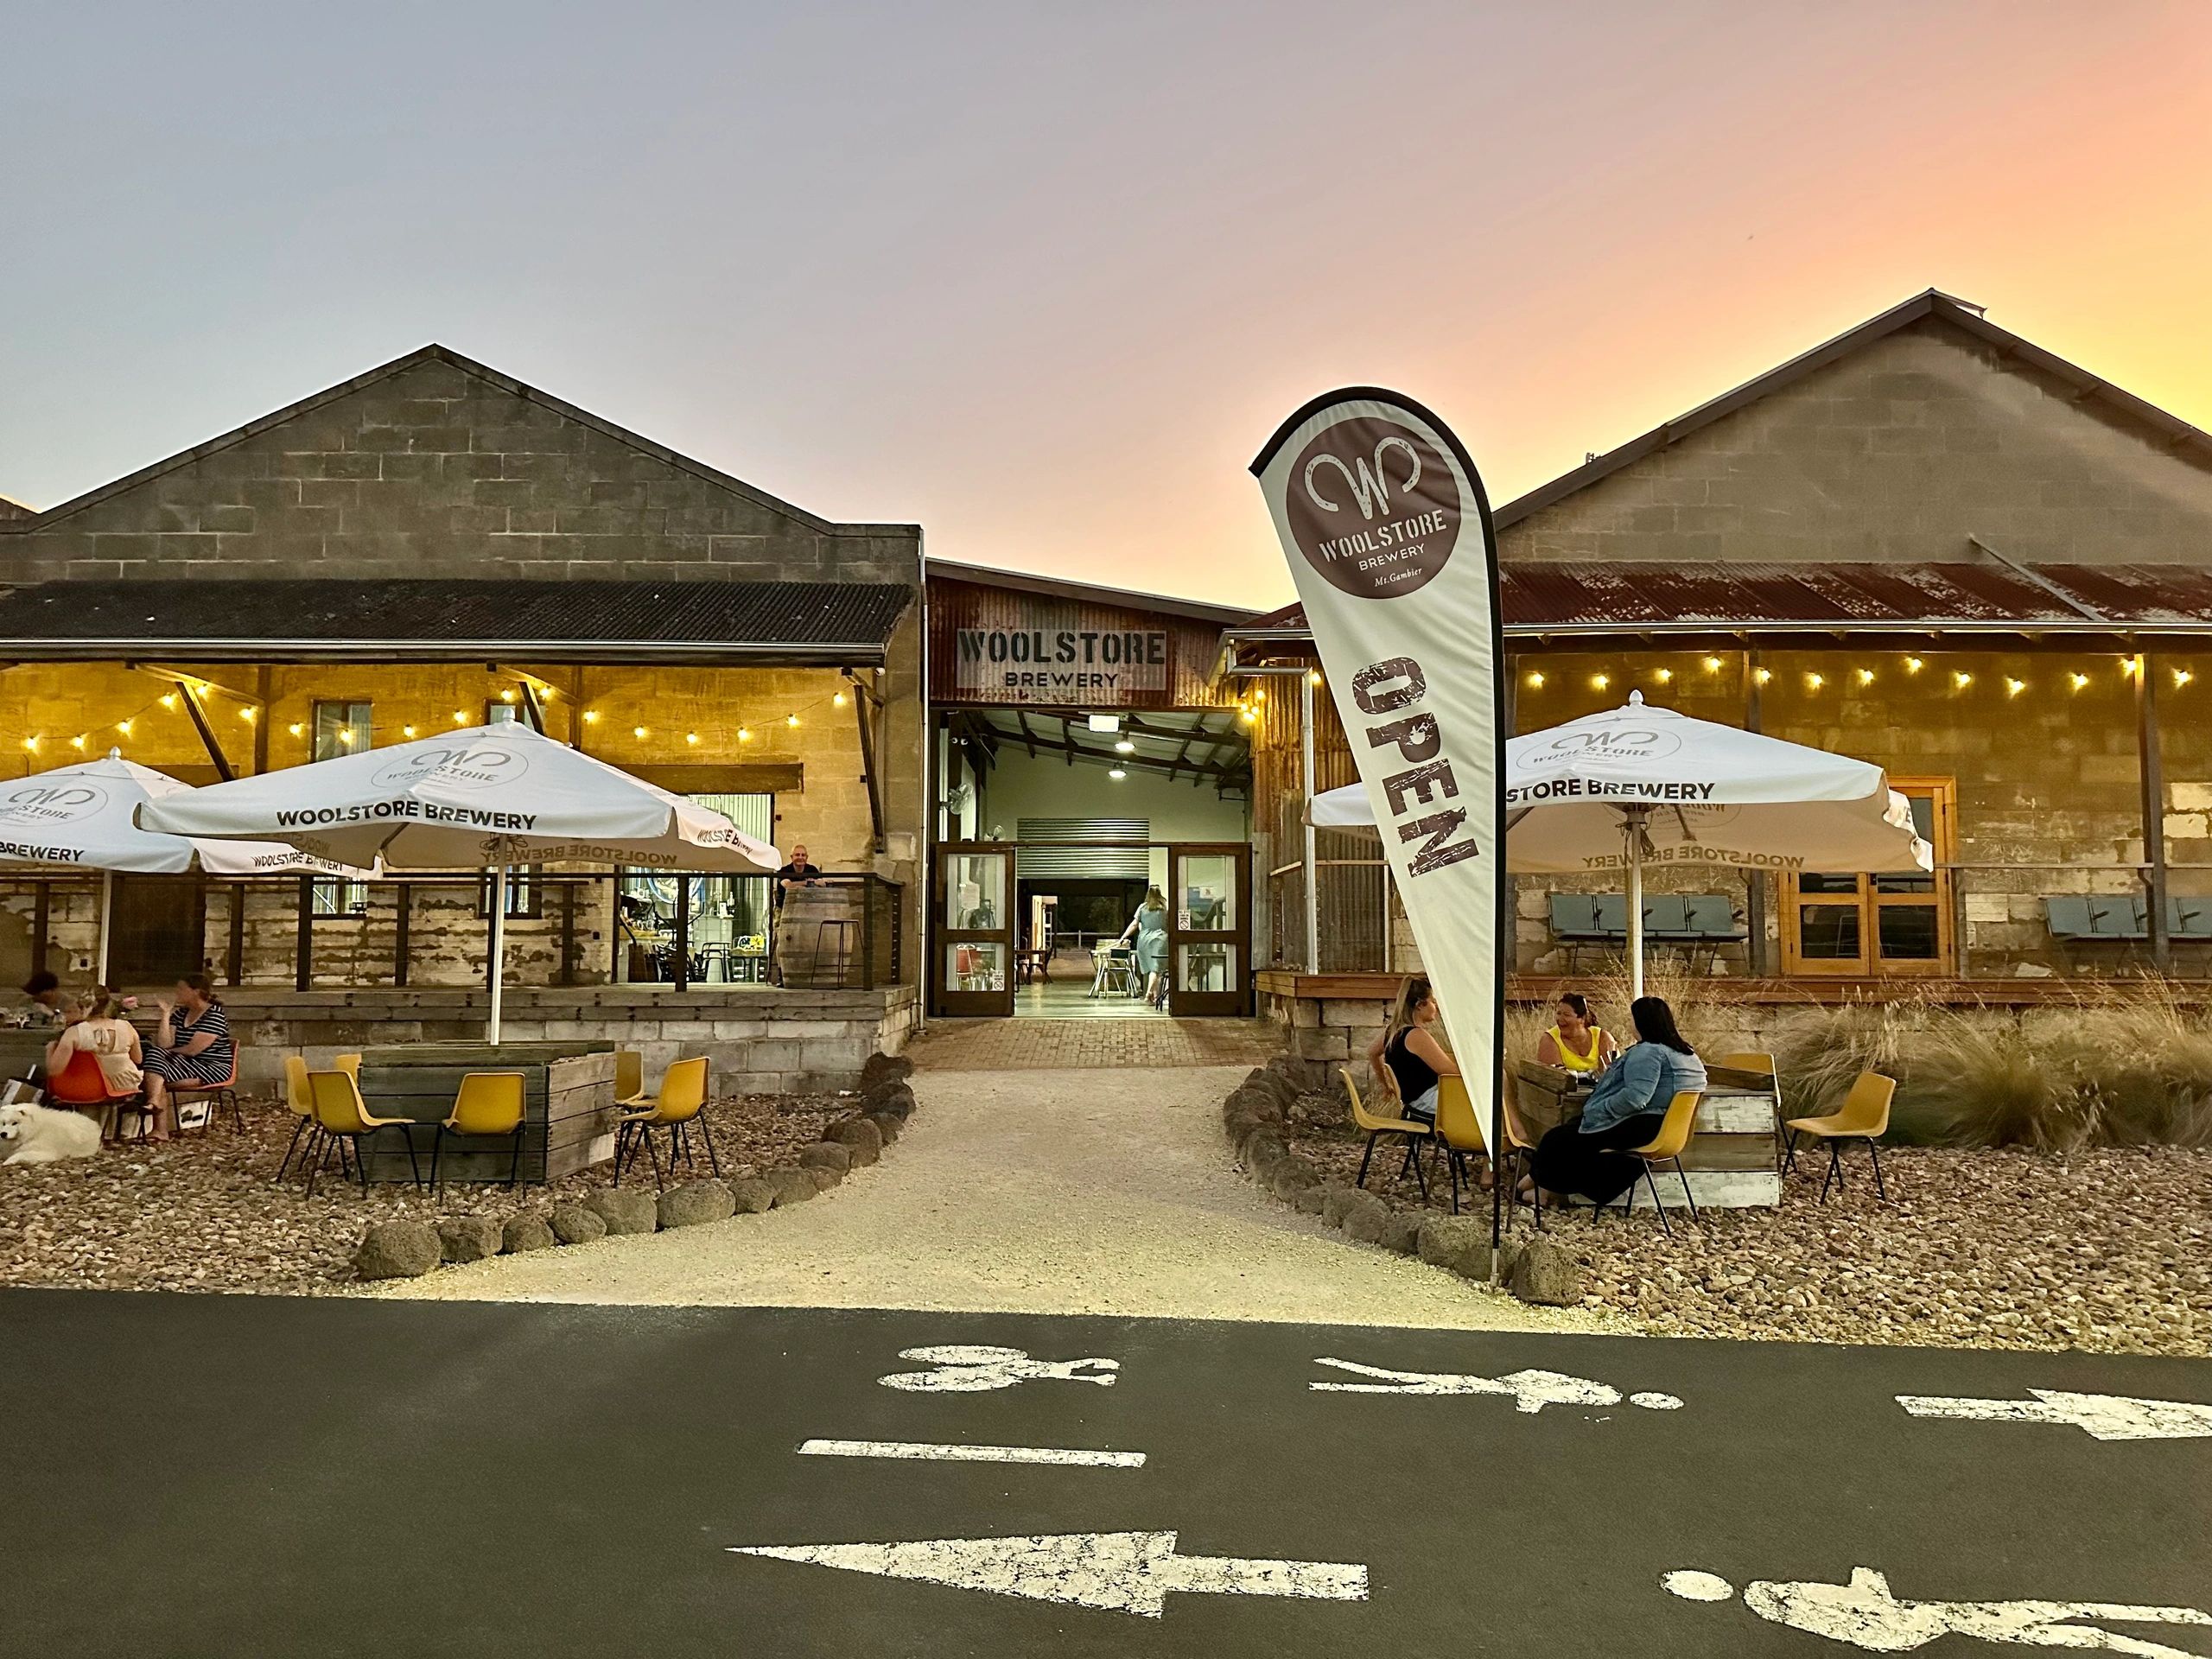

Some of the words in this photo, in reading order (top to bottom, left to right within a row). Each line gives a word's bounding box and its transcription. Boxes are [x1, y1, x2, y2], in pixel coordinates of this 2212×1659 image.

[1319, 509, 1447, 563] WOOLSTORE
[1358, 543, 1425, 571] BREWERY
[958, 631, 1166, 664] WOOLSTORE
[1005, 671, 1119, 688] BREWERY
[1352, 657, 1479, 878] OPEN
[1506, 779, 1581, 803] STORE
[1587, 779, 1716, 800] BREWERY
[276, 800, 419, 827] WOOLSTORE
[424, 803, 537, 830] BREWERY
[0, 841, 85, 862] BREWERY
